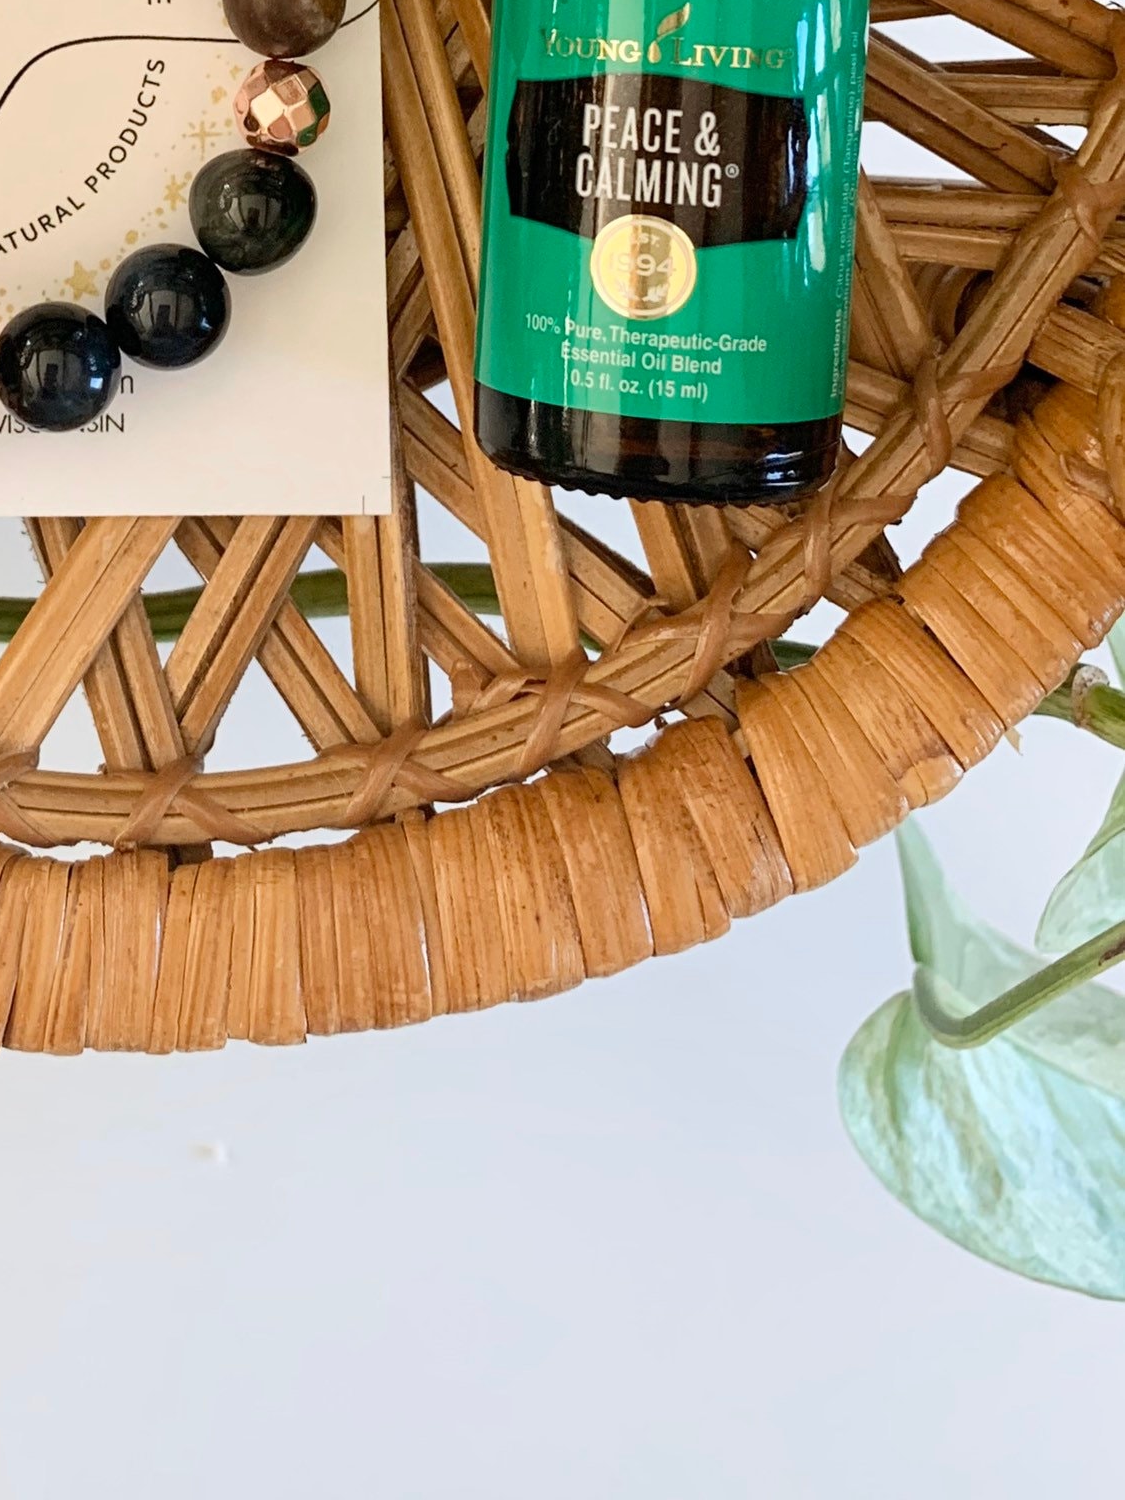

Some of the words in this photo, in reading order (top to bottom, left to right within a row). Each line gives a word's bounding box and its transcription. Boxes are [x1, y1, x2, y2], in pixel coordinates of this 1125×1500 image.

[83, 58, 166, 194] PRODUCTS
[582, 102, 684, 155] PEACE
[693, 110, 721, 157] &
[524, 312, 561, 335] 100%
[609, 324, 768, 353] Therapeutic-Grade
[560, 340, 636, 368] Essential
[641, 352, 667, 372] Oil
[671, 354, 723, 375] Blend
[570, 368, 595, 388] 0.5
[599, 372, 614, 391] fl.
[618, 379, 644, 395] oz.
[647, 378, 676, 400] (15
[680, 381, 709, 404] ml)
